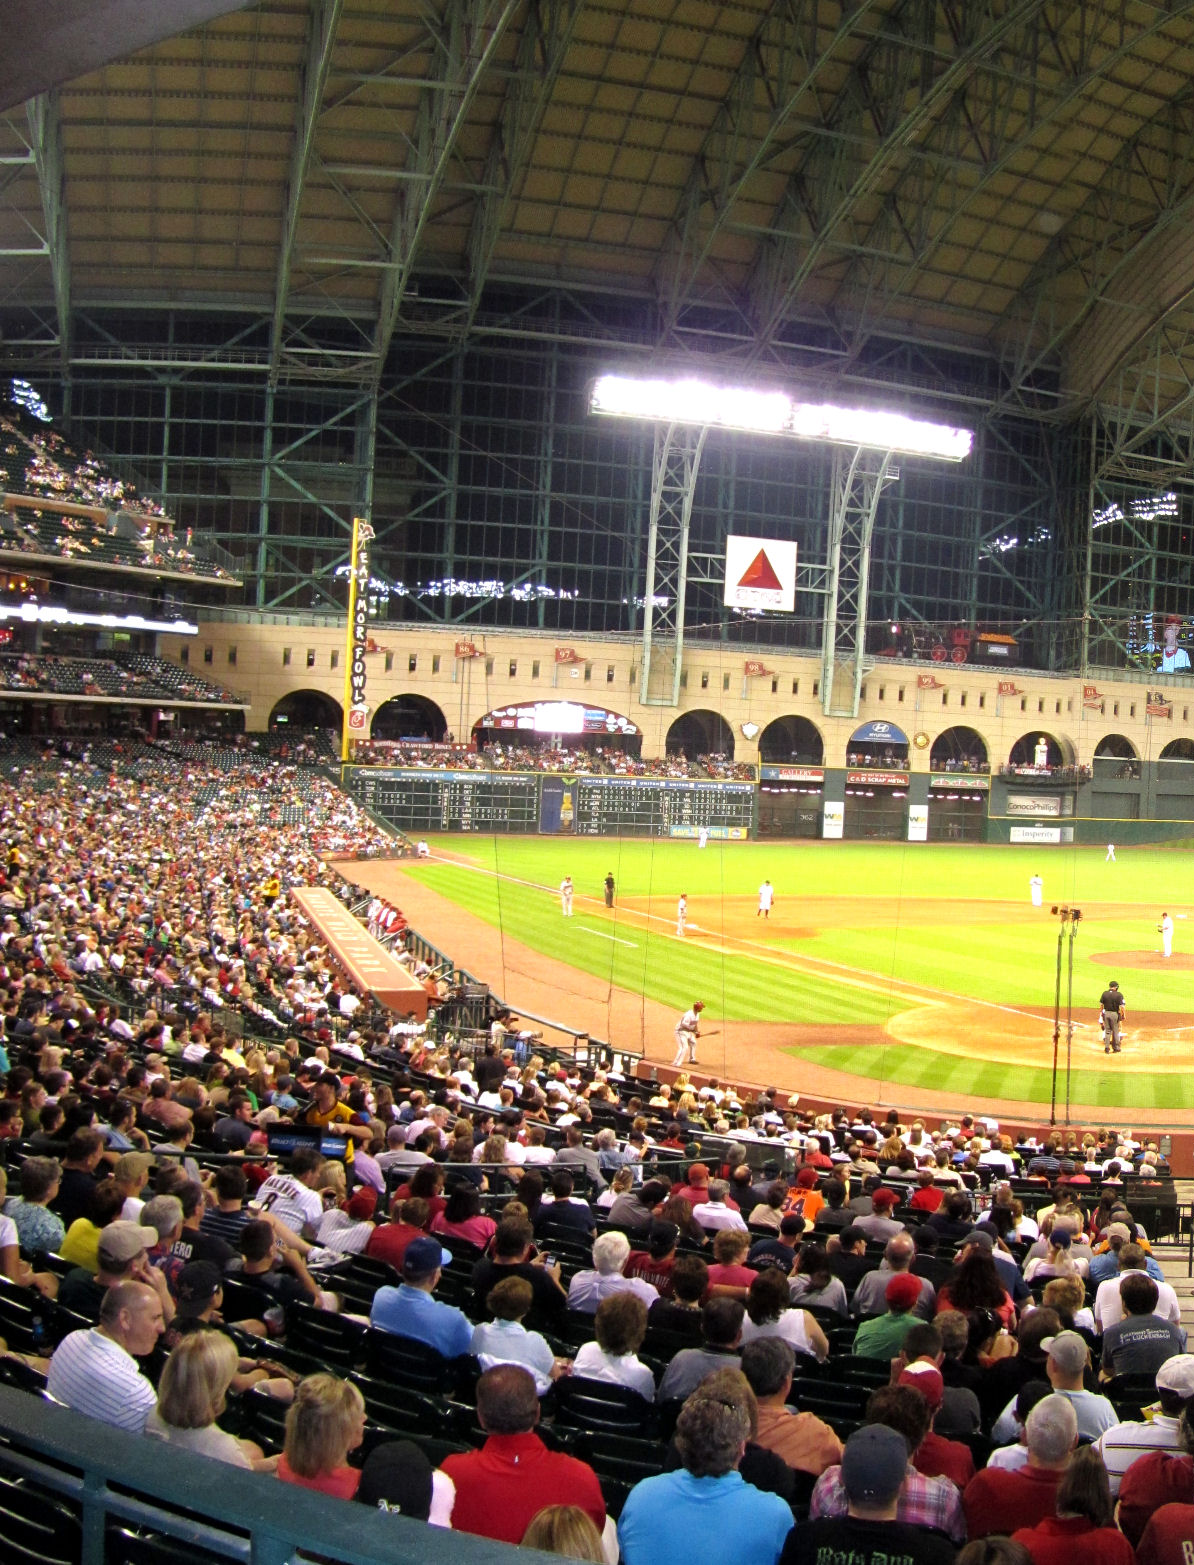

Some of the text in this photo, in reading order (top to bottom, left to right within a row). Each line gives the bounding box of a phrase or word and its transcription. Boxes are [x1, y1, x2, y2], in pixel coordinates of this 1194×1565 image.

[359, 552, 369, 592] EAT
[355, 599, 368, 639] MOR
[352, 647, 364, 702] FOWL
[1008, 800, 1058, 811] ConocoPhillips
[824, 813, 844, 821] WM
[1022, 829, 1054, 839] Insperity
[291, 1139, 316, 1147] LIGHT
[170, 1241, 194, 1259] ERO
